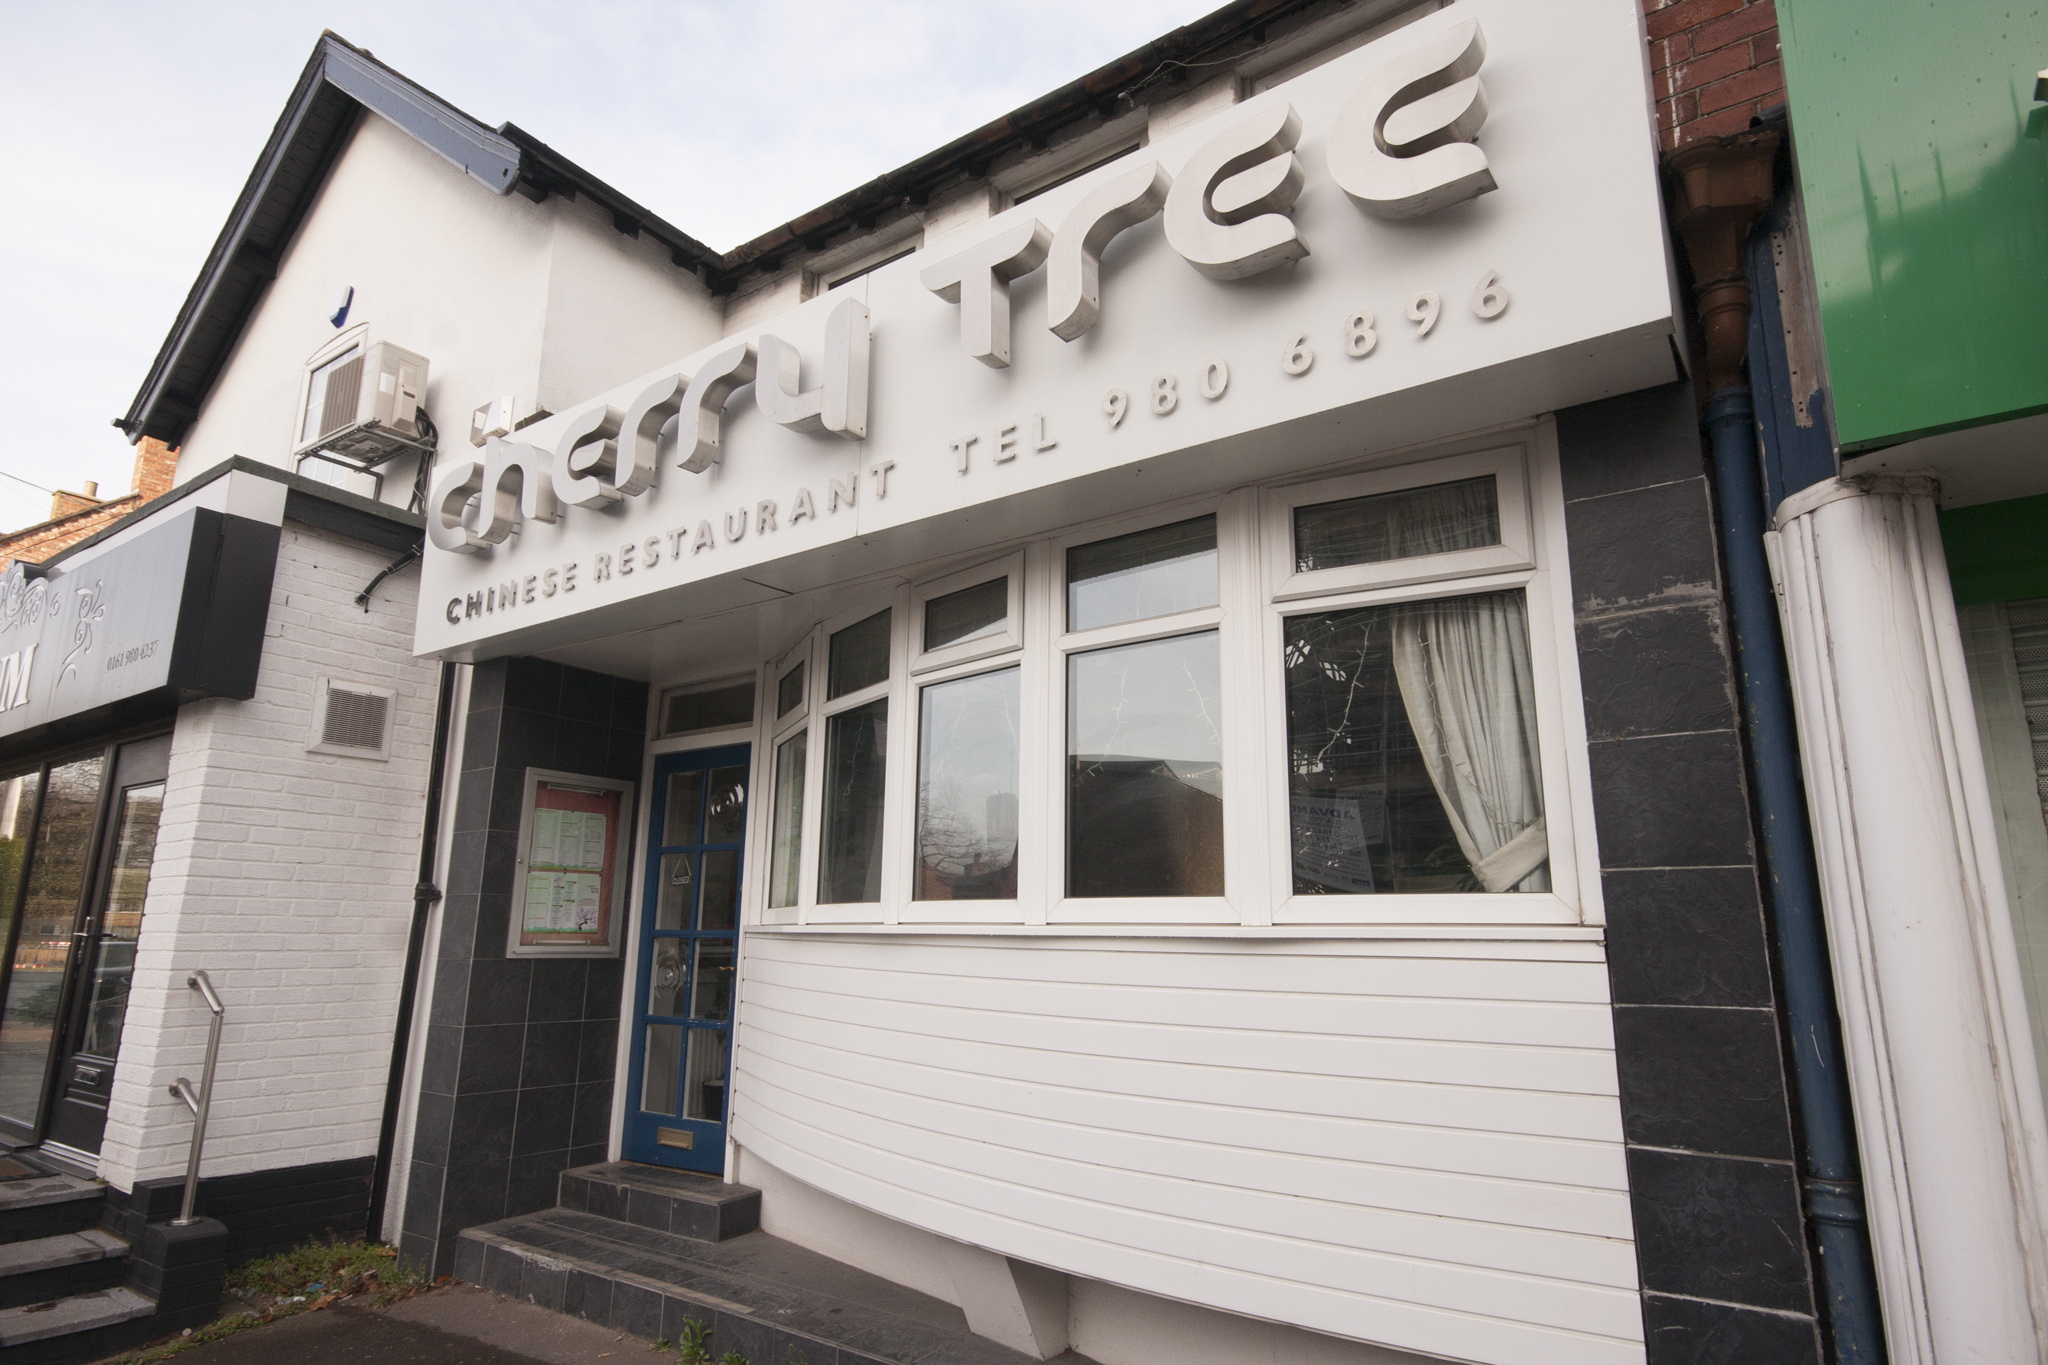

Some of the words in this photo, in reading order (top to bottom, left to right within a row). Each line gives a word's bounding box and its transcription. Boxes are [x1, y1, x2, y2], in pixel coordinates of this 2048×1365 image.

[446, 561, 578, 625] CHINESE
[593, 459, 895, 582] RESTAURANT
[949, 412, 1057, 473] TEL
[1103, 357, 1229, 428] 980
[1282, 268, 1509, 376] 6896
[106, 652, 124, 672] 0161
[124, 647, 140, 667] 980
[672, 875, 690, 885] CLOSED
